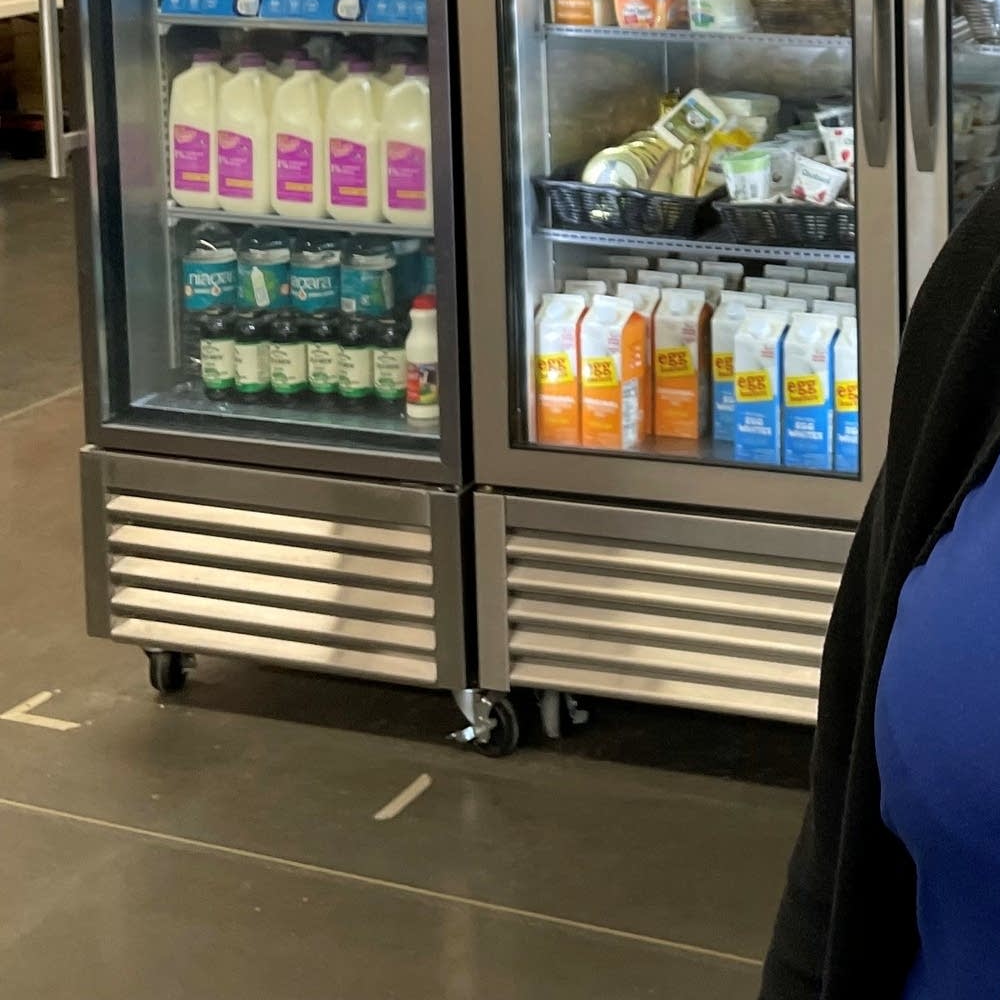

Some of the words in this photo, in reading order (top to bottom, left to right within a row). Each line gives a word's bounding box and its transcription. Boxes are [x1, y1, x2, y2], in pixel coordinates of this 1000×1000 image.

[658, 350, 688, 367] egg
[715, 356, 733, 372] eg
[737, 374, 766, 391] egg
[787, 379, 817, 396] egg
